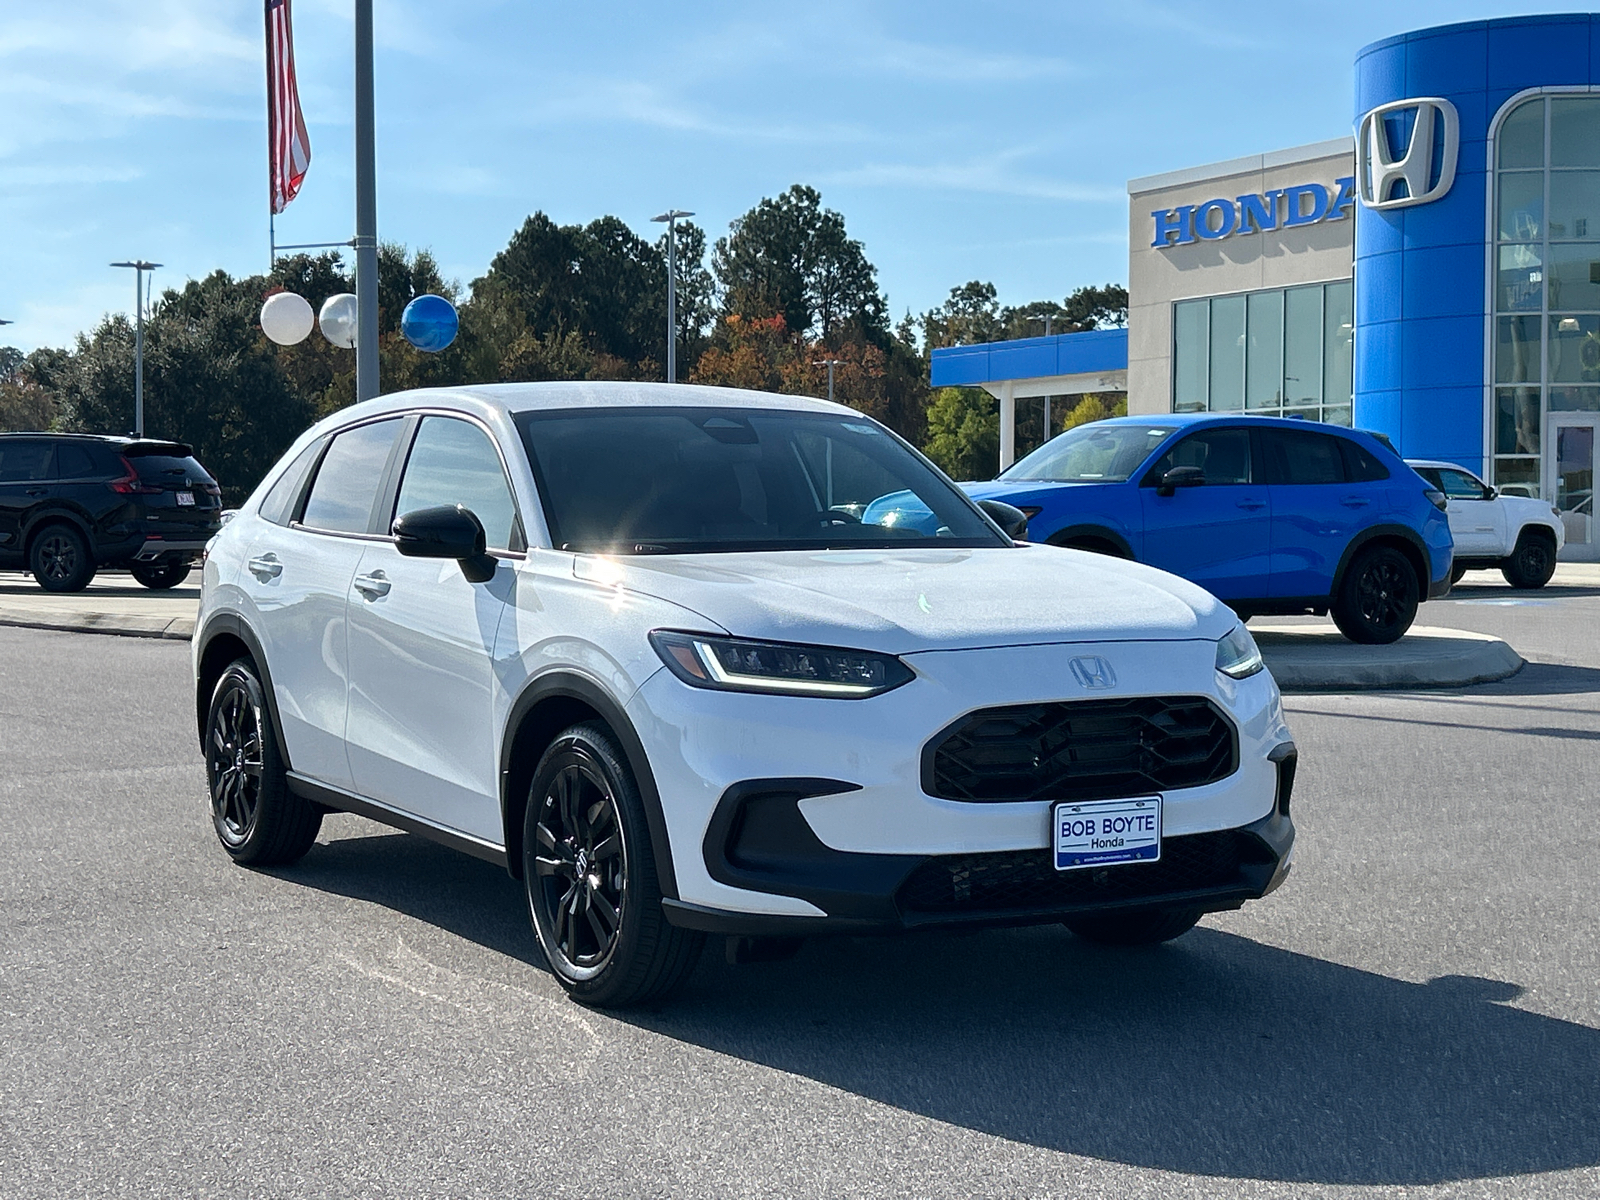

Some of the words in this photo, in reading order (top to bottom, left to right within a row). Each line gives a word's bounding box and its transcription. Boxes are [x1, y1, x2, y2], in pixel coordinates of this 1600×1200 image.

[1061, 820, 1095, 837] BOB
[1103, 815, 1155, 834] BOYTE
[1091, 837, 1124, 849] Honda
